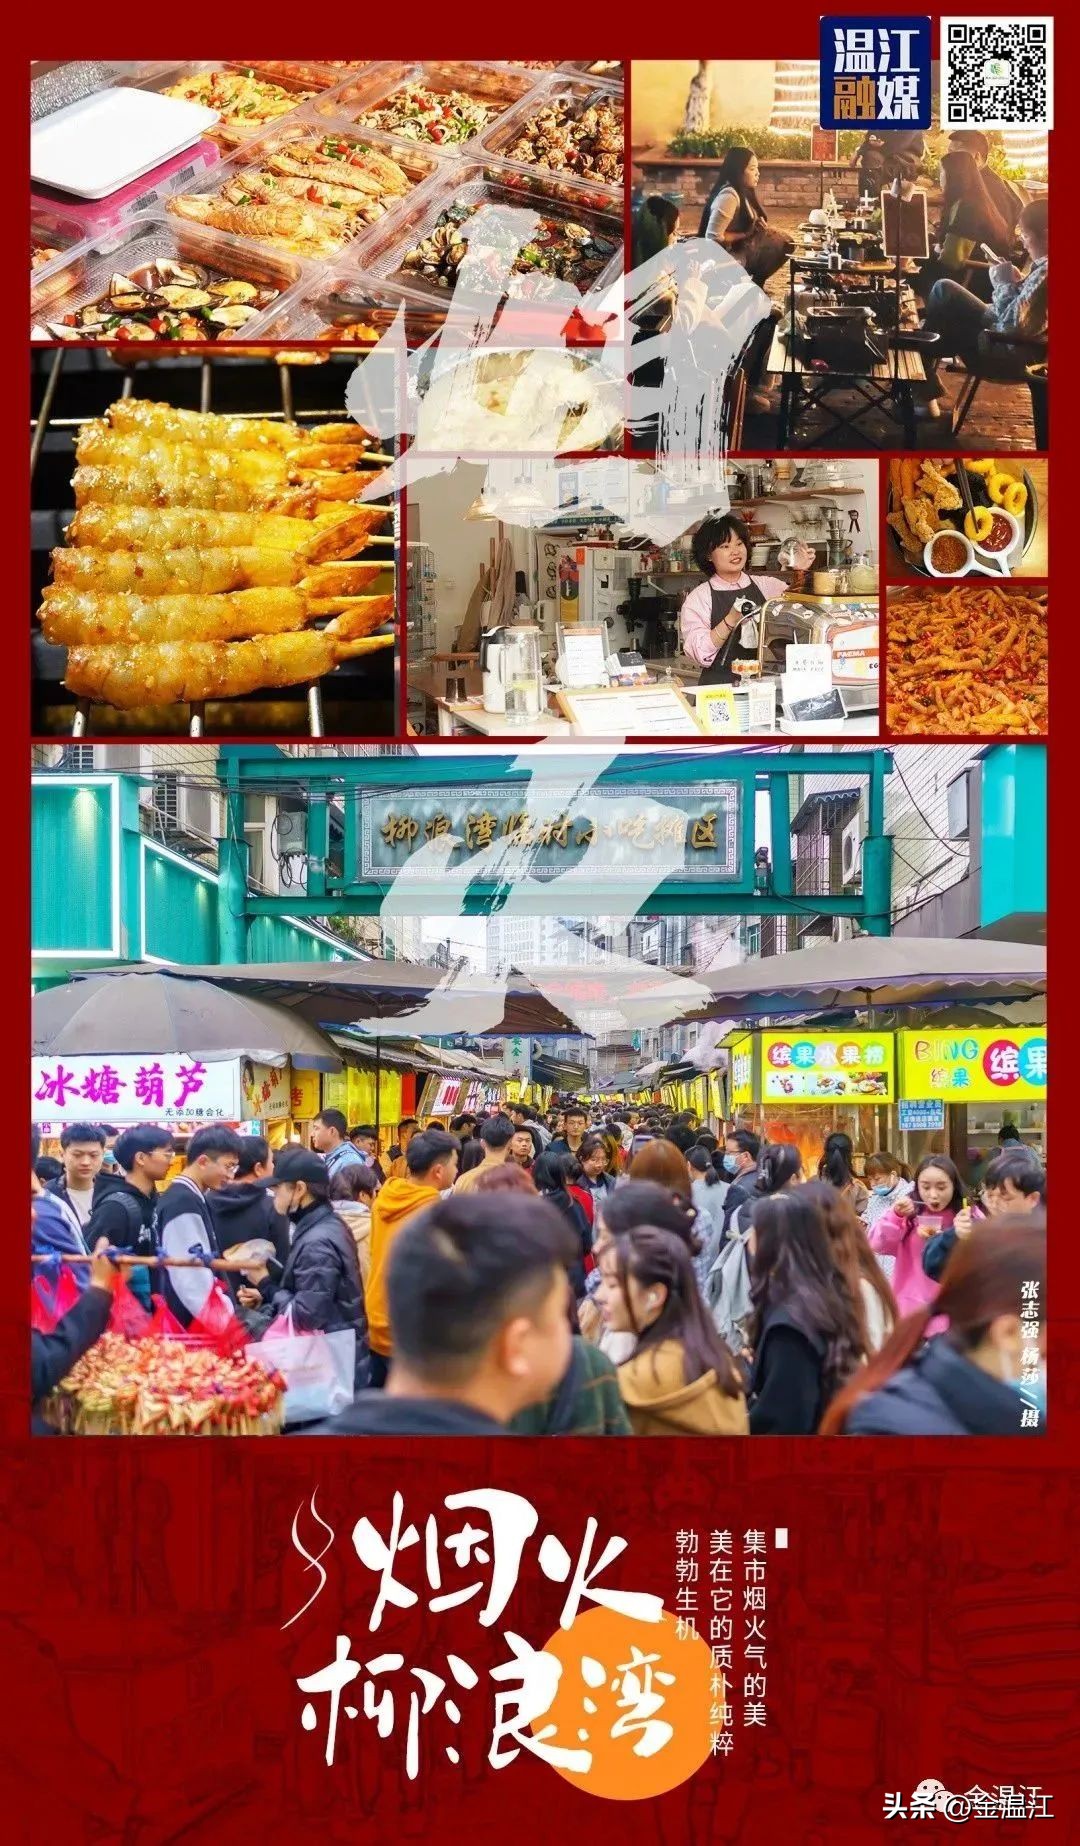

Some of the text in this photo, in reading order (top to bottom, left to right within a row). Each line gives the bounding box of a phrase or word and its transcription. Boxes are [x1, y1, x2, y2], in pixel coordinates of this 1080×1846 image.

[914, 1038, 979, 1061] BING
[34, 1061, 208, 1108] 冰糖葫芦
